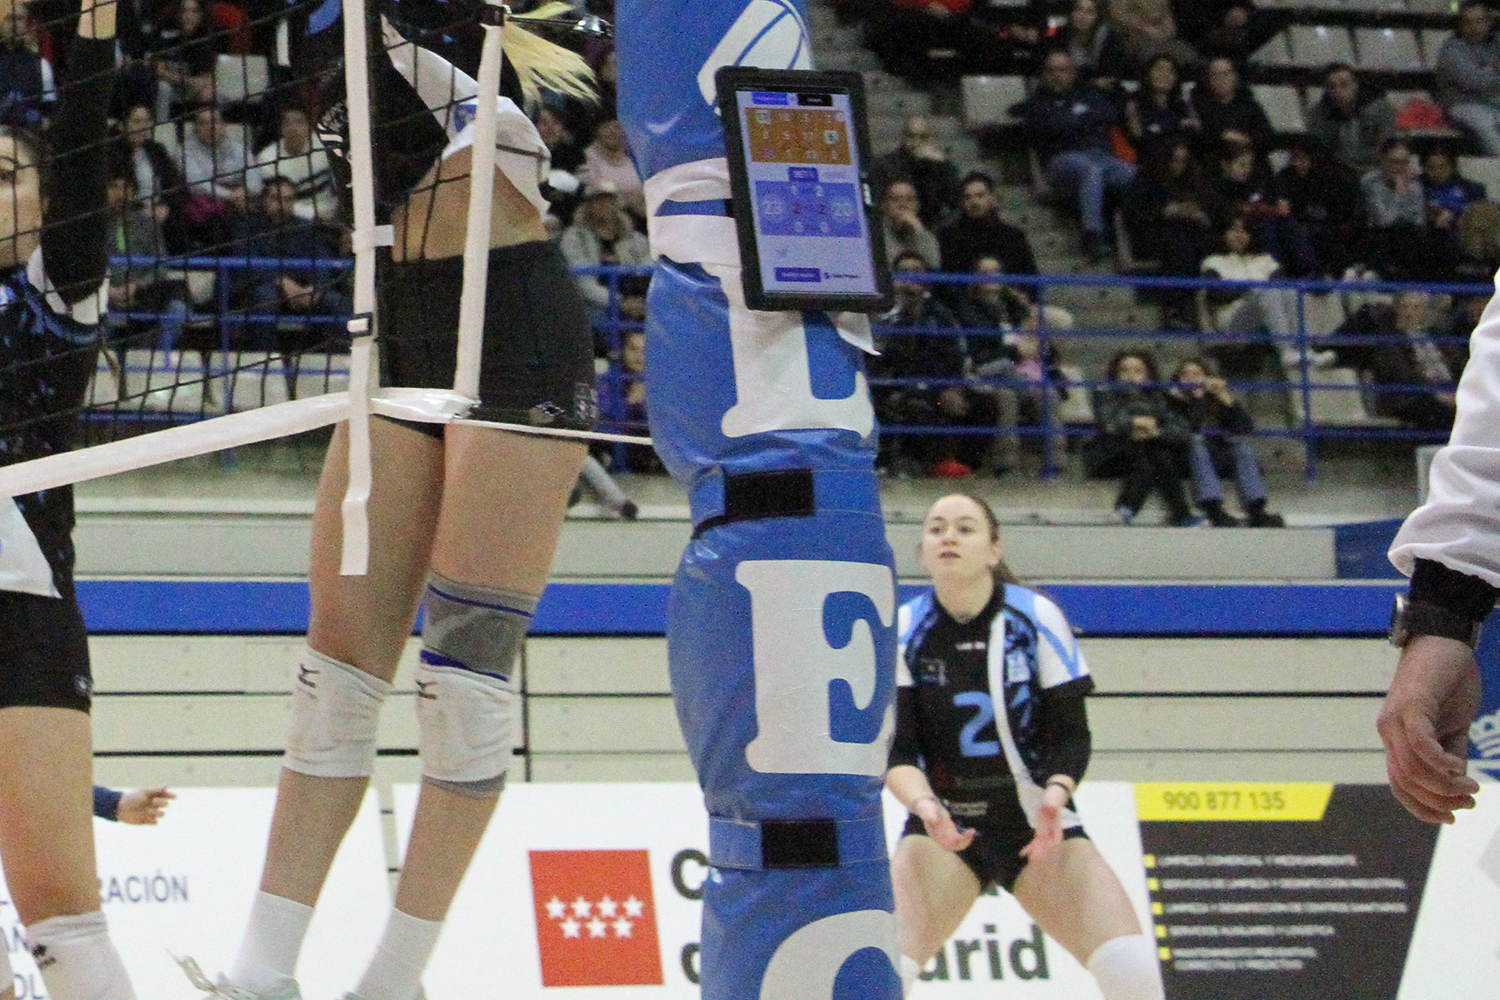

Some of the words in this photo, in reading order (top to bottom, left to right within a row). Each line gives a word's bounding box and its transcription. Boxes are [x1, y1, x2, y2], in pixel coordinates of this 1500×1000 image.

[953, 691, 1000, 758] 2
[1163, 790, 1199, 811] 900
[1205, 790, 1241, 811] 877
[1249, 790, 1285, 811] 135
